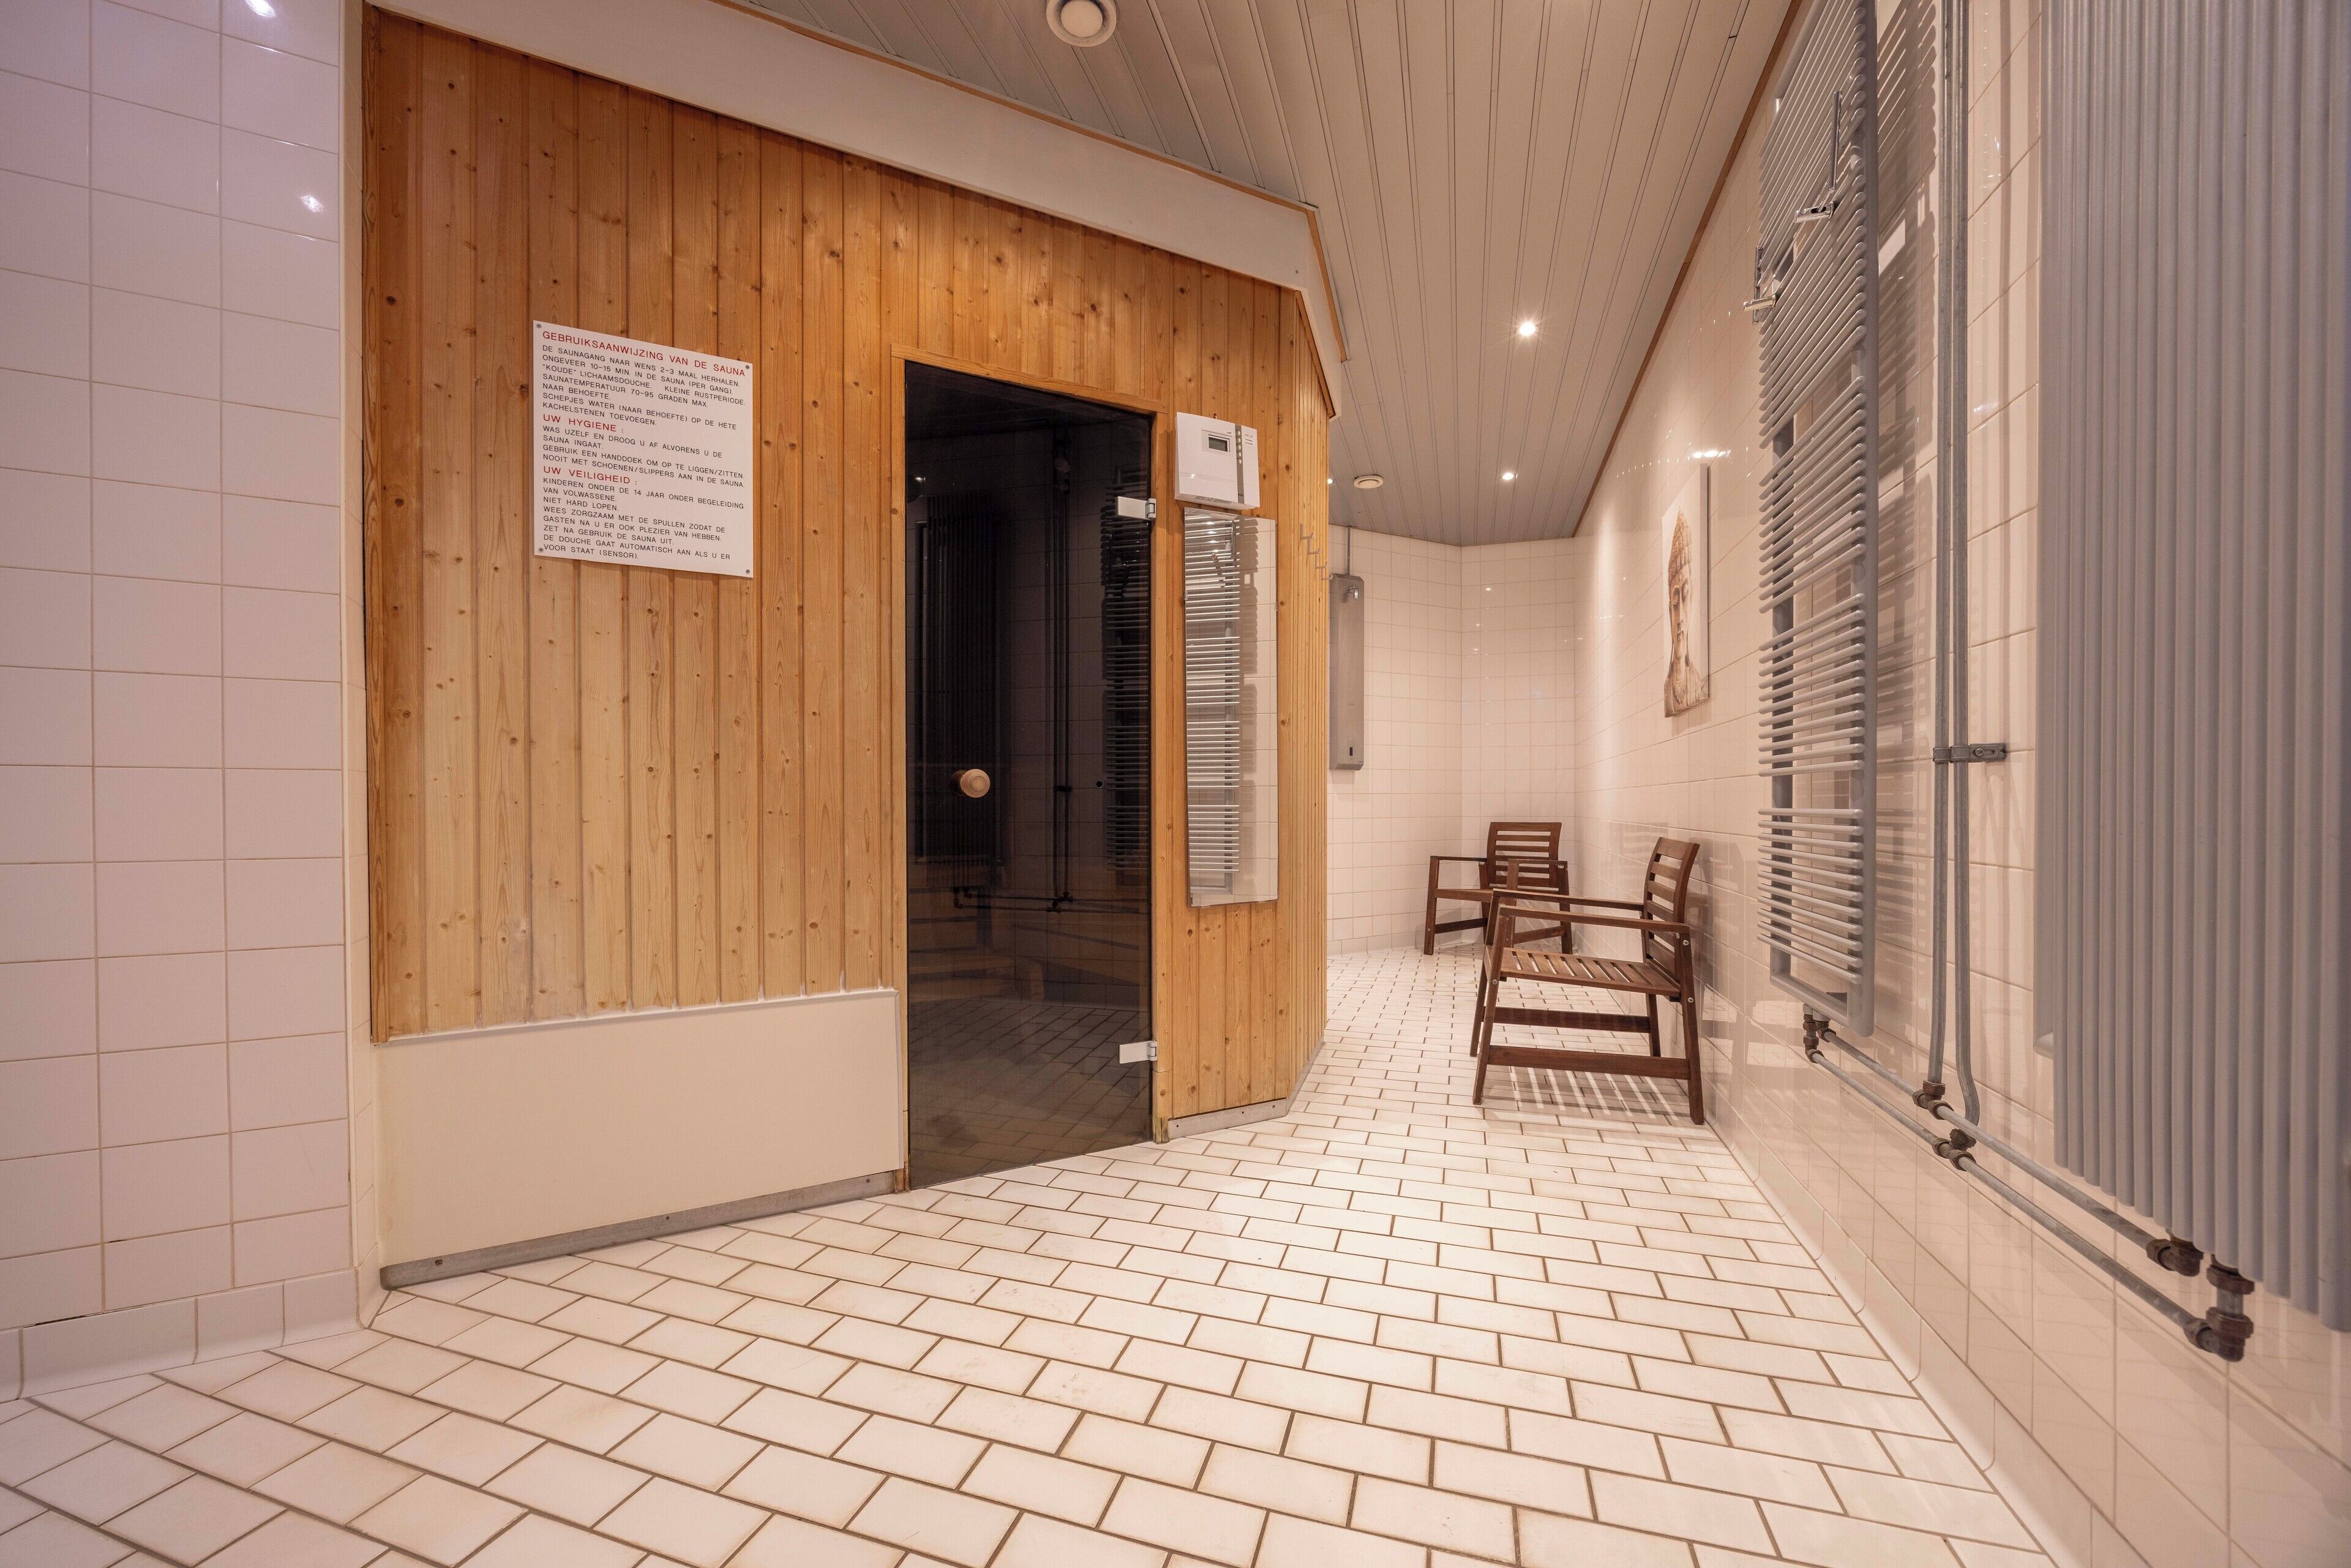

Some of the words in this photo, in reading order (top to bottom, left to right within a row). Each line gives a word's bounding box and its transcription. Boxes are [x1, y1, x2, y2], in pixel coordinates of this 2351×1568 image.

[542, 331, 663, 361] GEBRUIKSAANWIJZING
[669, 354, 688, 366] VAN
[694, 359, 707, 369] DE
[713, 364, 744, 377] SAUNA
[542, 354, 585, 367] ONGEVEER
[590, 363, 611, 372] 10-15
[661, 375, 685, 385] SAUNA
[709, 384, 733, 394] GANG).
[558, 347, 605, 361] SAUNAGANG
[609, 357, 629, 366] NAAR
[634, 362, 656, 371] WENS
[678, 370, 697, 379] MAAL
[701, 374, 740, 387] HERHALEN.
[542, 364, 576, 375] "KOUDE"
[580, 370, 651, 388] LICHAAMSDOUCHE.
[664, 385, 690, 396] KLEINE
[694, 391, 745, 405] RUSTPERIODE.
[542, 373, 626, 393] SAUNATEMPERATUUR
[631, 388, 653, 397] 70-95
[658, 393, 688, 403] GRADEN
[542, 383, 563, 392] NAAR
[568, 387, 610, 400] BEHOEFTE.
[542, 392, 583, 404] SCHEPJES
[588, 400, 615, 410] WATER
[618, 405, 642, 414] (NAAR
[646, 409, 687, 421] BEHOEFTE)
[718, 421, 736, 430] HETE
[542, 402, 604, 417] KACHELSTENEN
[609, 412, 656, 426] TOEVOEGEN.
[543, 413, 561, 423] UW
[569, 418, 616, 432] HYGIENE
[542, 425, 560, 433] WAS
[564, 429, 589, 437] UZELF
[608, 435, 636, 445] DROOG
[662, 443, 700, 454] ALVORENS
[542, 434, 569, 444] SAUNA
[574, 439, 603, 449] INGAAT.
[542, 444, 577, 455] GEBRUIK
[601, 452, 642, 464] HANDDOEK
[688, 465, 744, 479] LIGGEN/ZITTEN.
[543, 454, 568, 462] NOOIT
[591, 460, 674, 478] SCHOENEN/SLIPPERS
[720, 479, 744, 487] SAUNA.
[544, 465, 561, 475] UW
[568, 469, 630, 484] VEILIGHEID
[543, 477, 583, 488] KINDEREN
[588, 483, 615, 492] ONDER
[668, 493, 694, 502] ONDER
[697, 497, 744, 509] BEGELEIDING
[563, 489, 617, 501] VOLWASSENE.
[571, 509, 613, 519] ZORGZAAM
[653, 519, 684, 528] SPULLEN
[592, 502, 618, 511] LOPEN.
[543, 515, 575, 524] GASTEN
[639, 526, 670, 535] PLEZIER
[692, 532, 721, 541] HEBBEN.
[578, 528, 612, 538] GEBRUIK
[558, 536, 591, 545] DOUCHE
[619, 542, 672, 553] AUTOMATISCH
[599, 549, 638, 559] (SENSOR).
